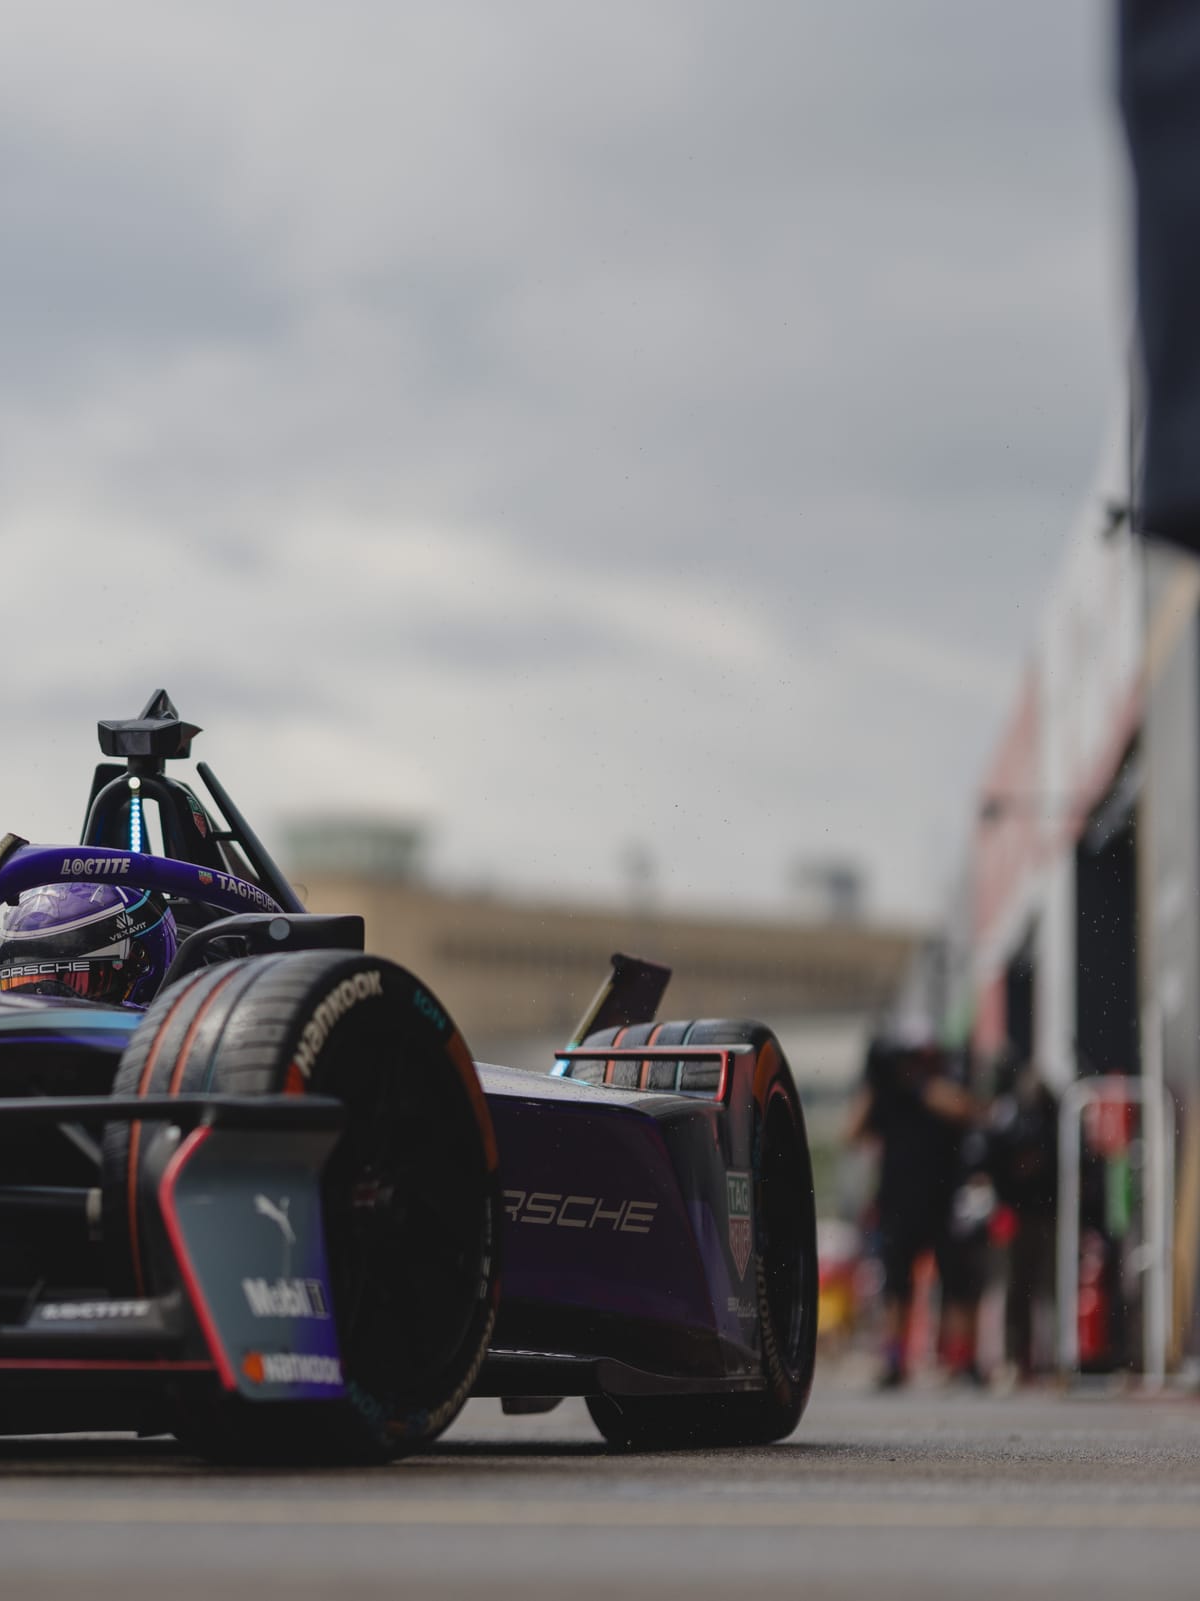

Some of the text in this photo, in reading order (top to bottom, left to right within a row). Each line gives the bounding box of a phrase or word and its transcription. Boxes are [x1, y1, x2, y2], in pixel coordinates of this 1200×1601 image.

[60, 857, 131, 876] LOCTITE
[503, 1189, 658, 1233] RSCHE
[728, 1179, 750, 1212] TAG
